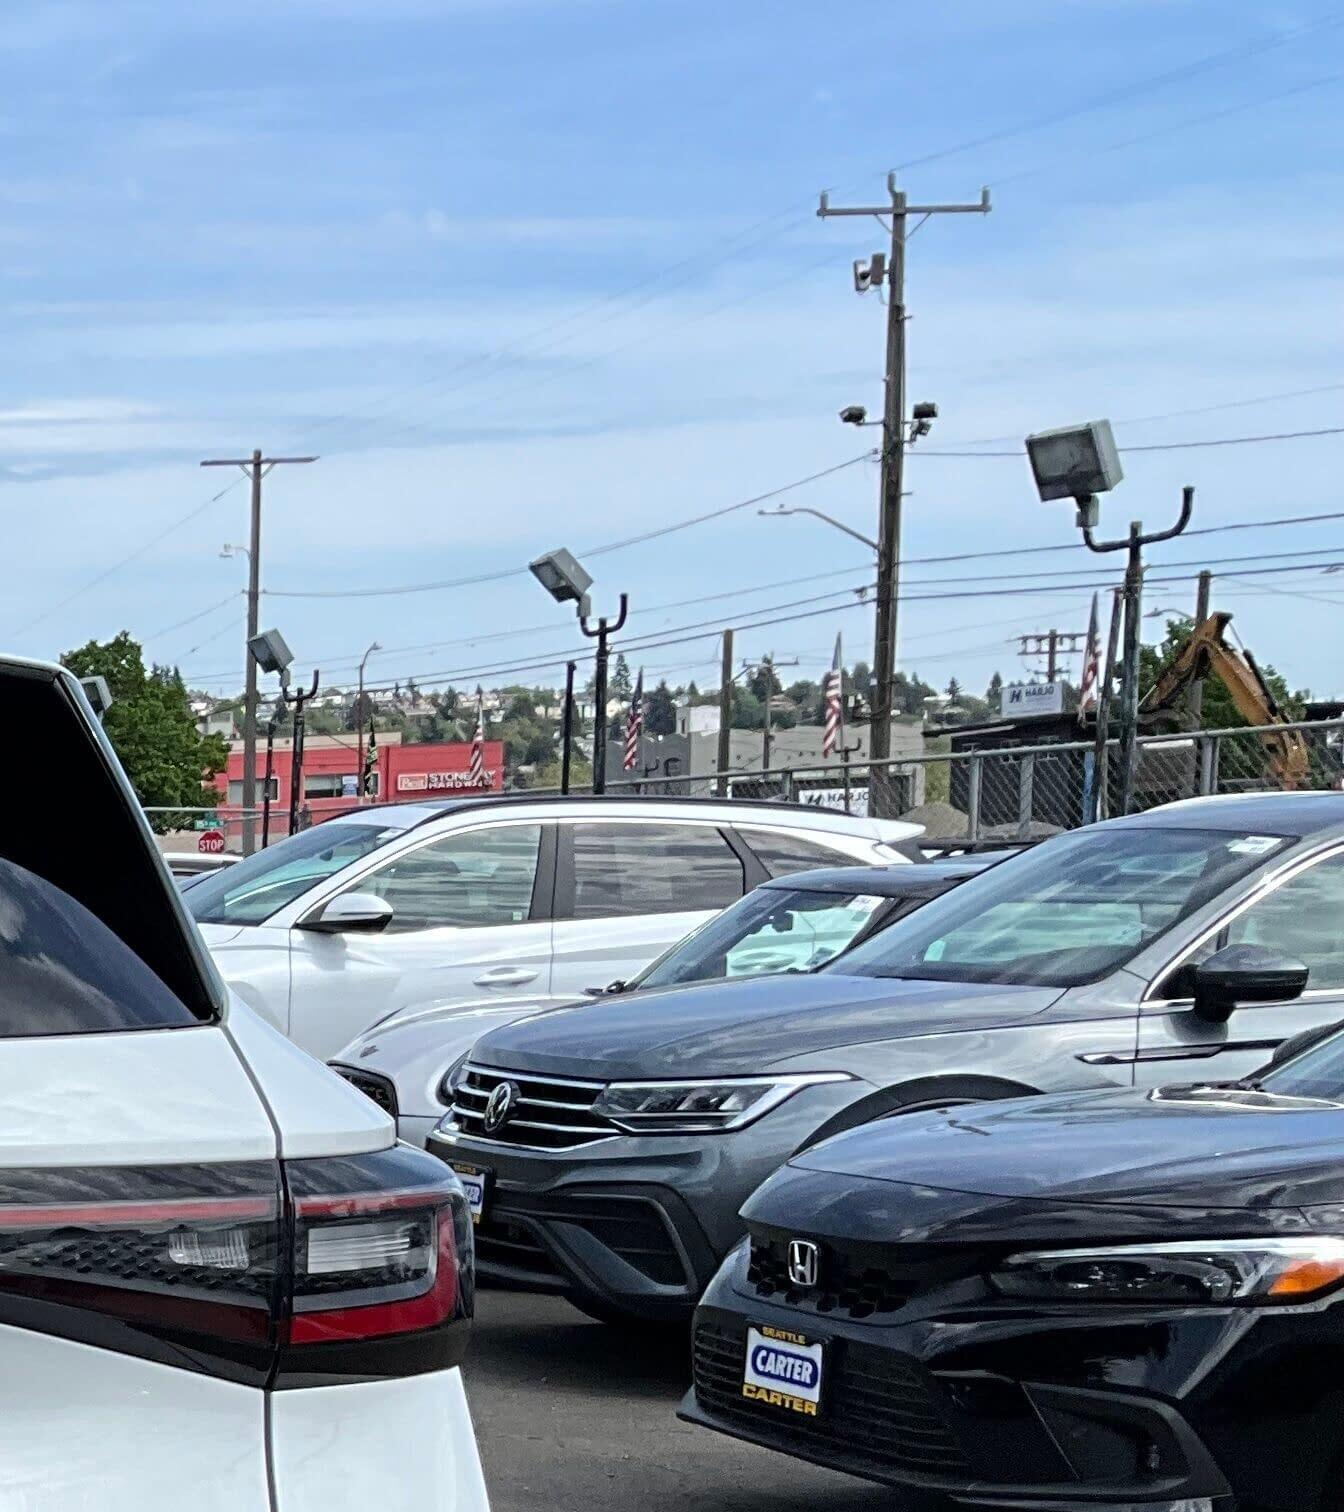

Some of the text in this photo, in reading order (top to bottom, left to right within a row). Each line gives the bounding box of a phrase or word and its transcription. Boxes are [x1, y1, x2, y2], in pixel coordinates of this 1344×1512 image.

[199, 839, 224, 851] STOP
[762, 1325, 806, 1345] SEATTLE
[755, 1349, 813, 1385] CARTER
[742, 1384, 817, 1416] CARTER
